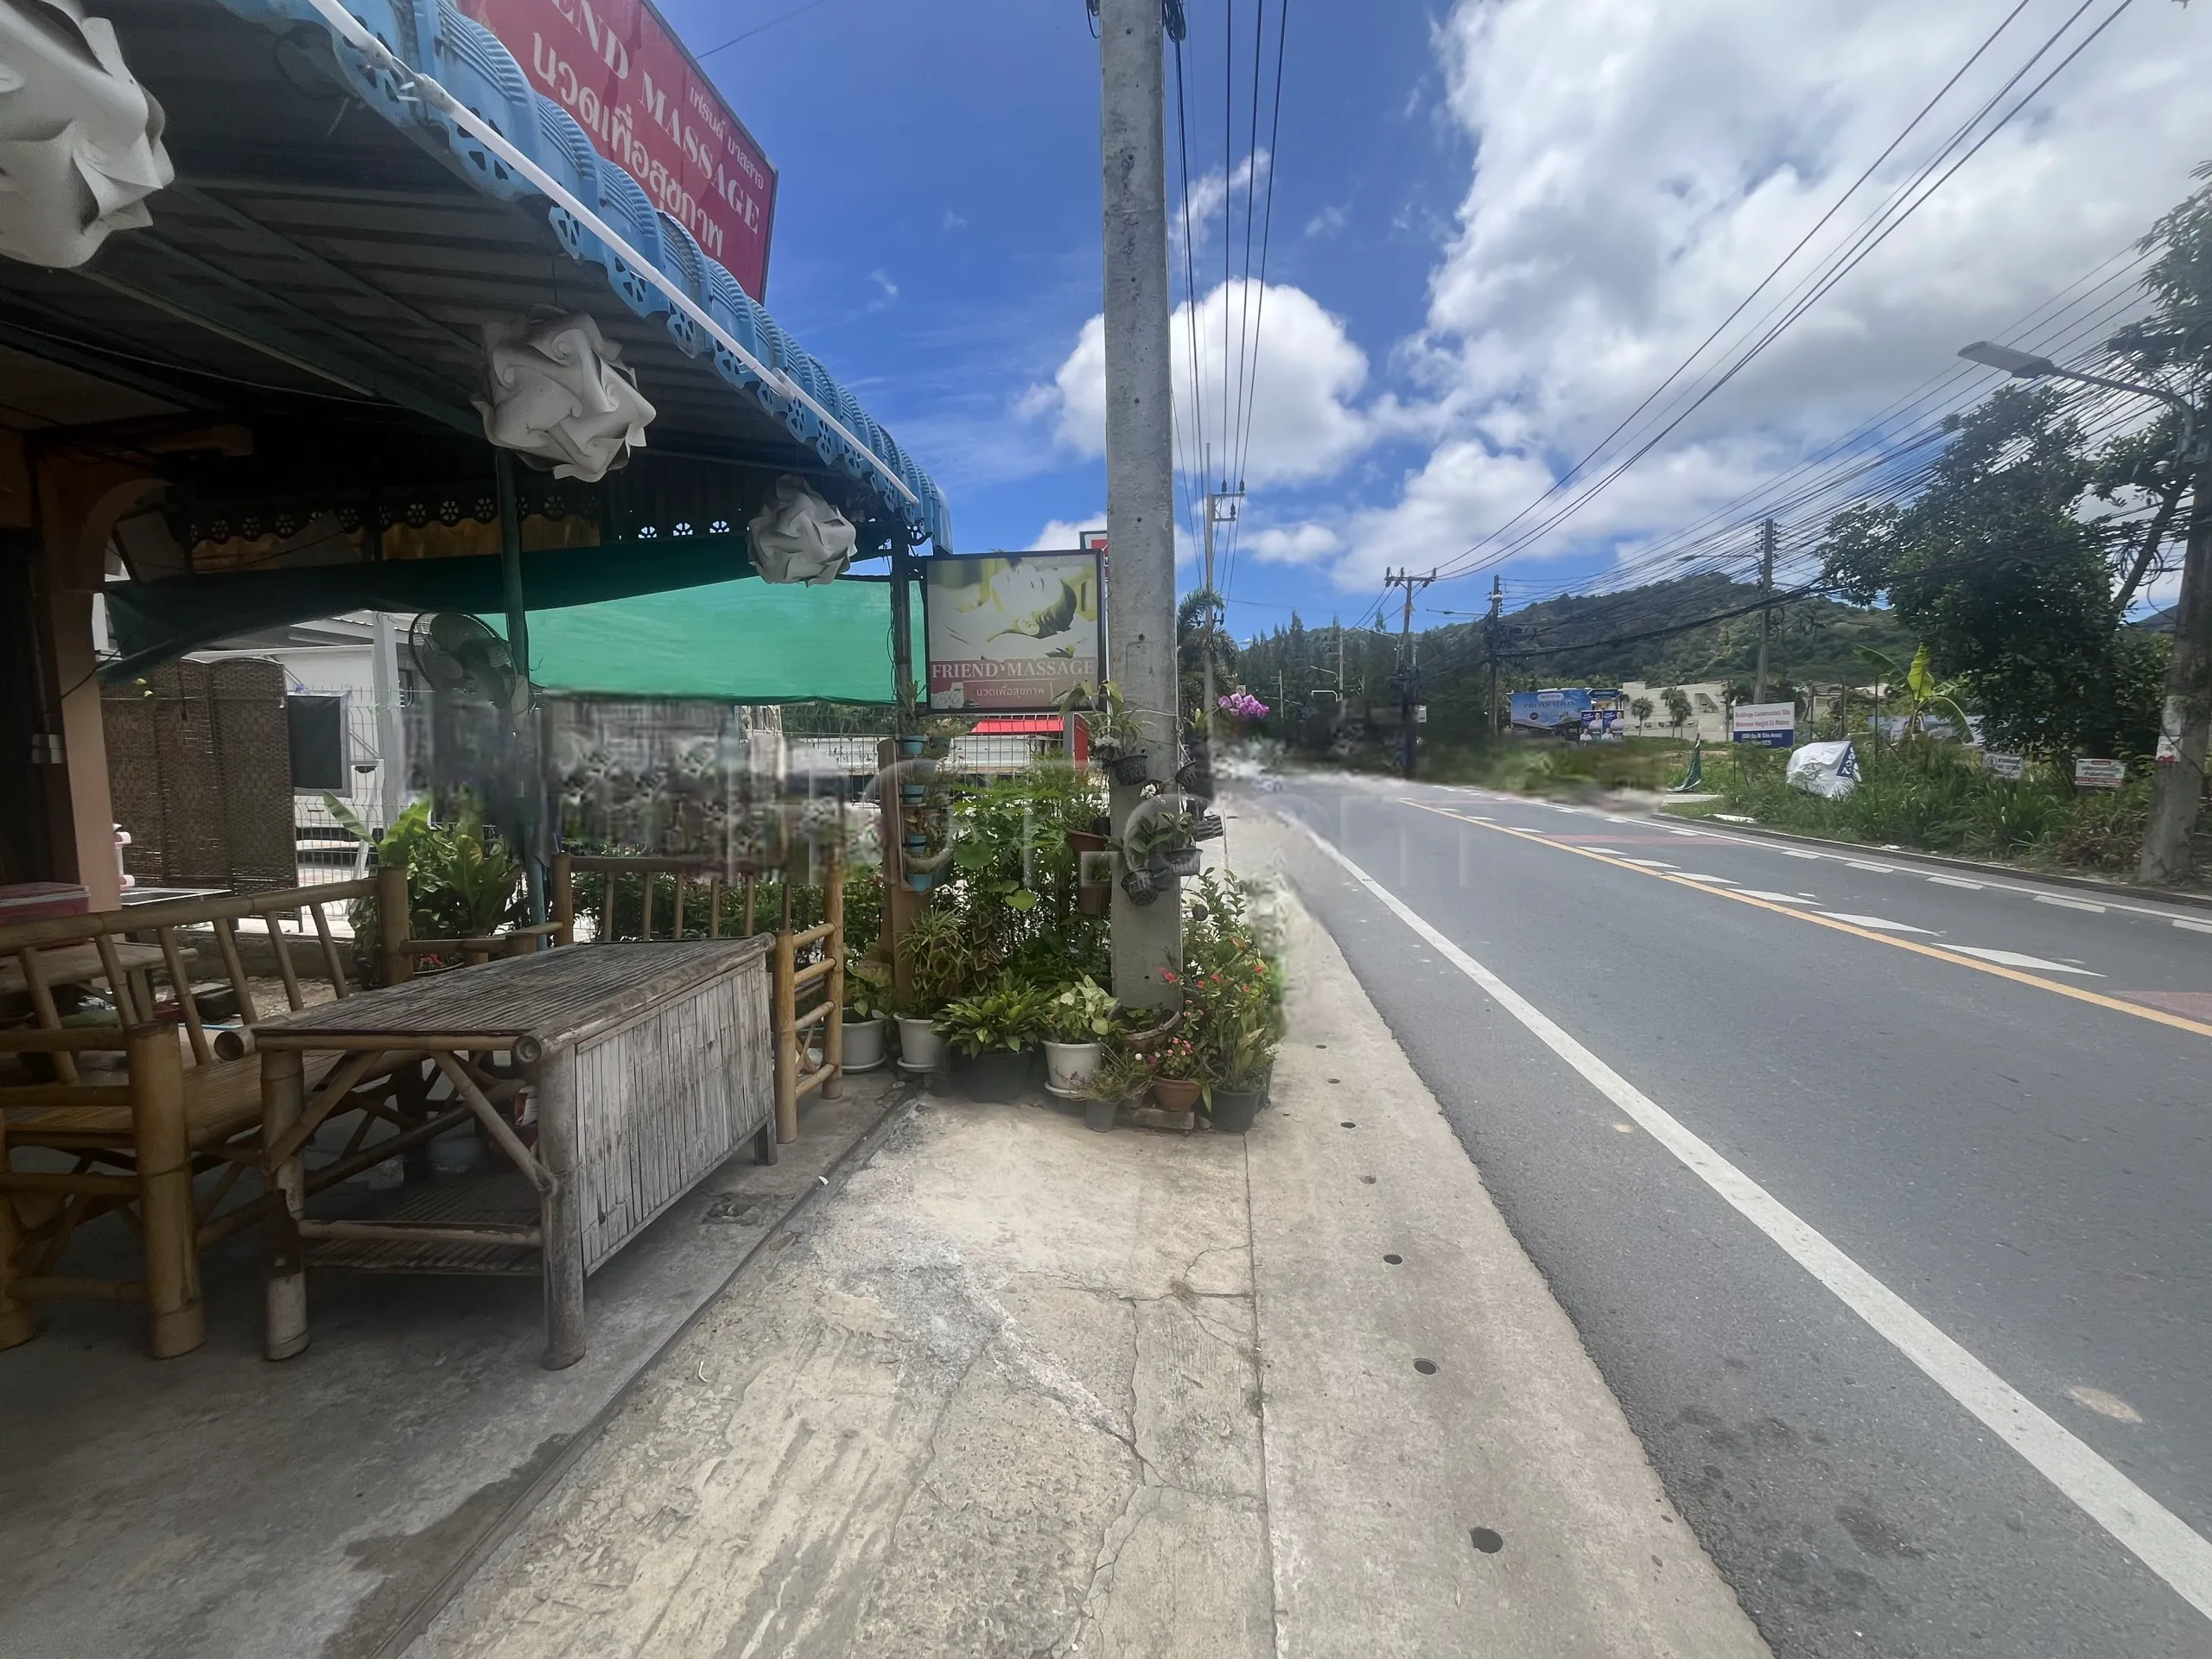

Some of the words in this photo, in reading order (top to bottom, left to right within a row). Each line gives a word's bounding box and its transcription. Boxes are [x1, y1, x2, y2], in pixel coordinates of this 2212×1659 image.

[532, 31, 723, 257] นวดเพื่อสุขภาพ
[638, 68, 760, 235] MASSAGE
[931, 663, 999, 678] FRIEND
[1007, 659, 1095, 677] MASSAGE
[976, 683, 1045, 699] นวดเพื่อสุขภาพ
